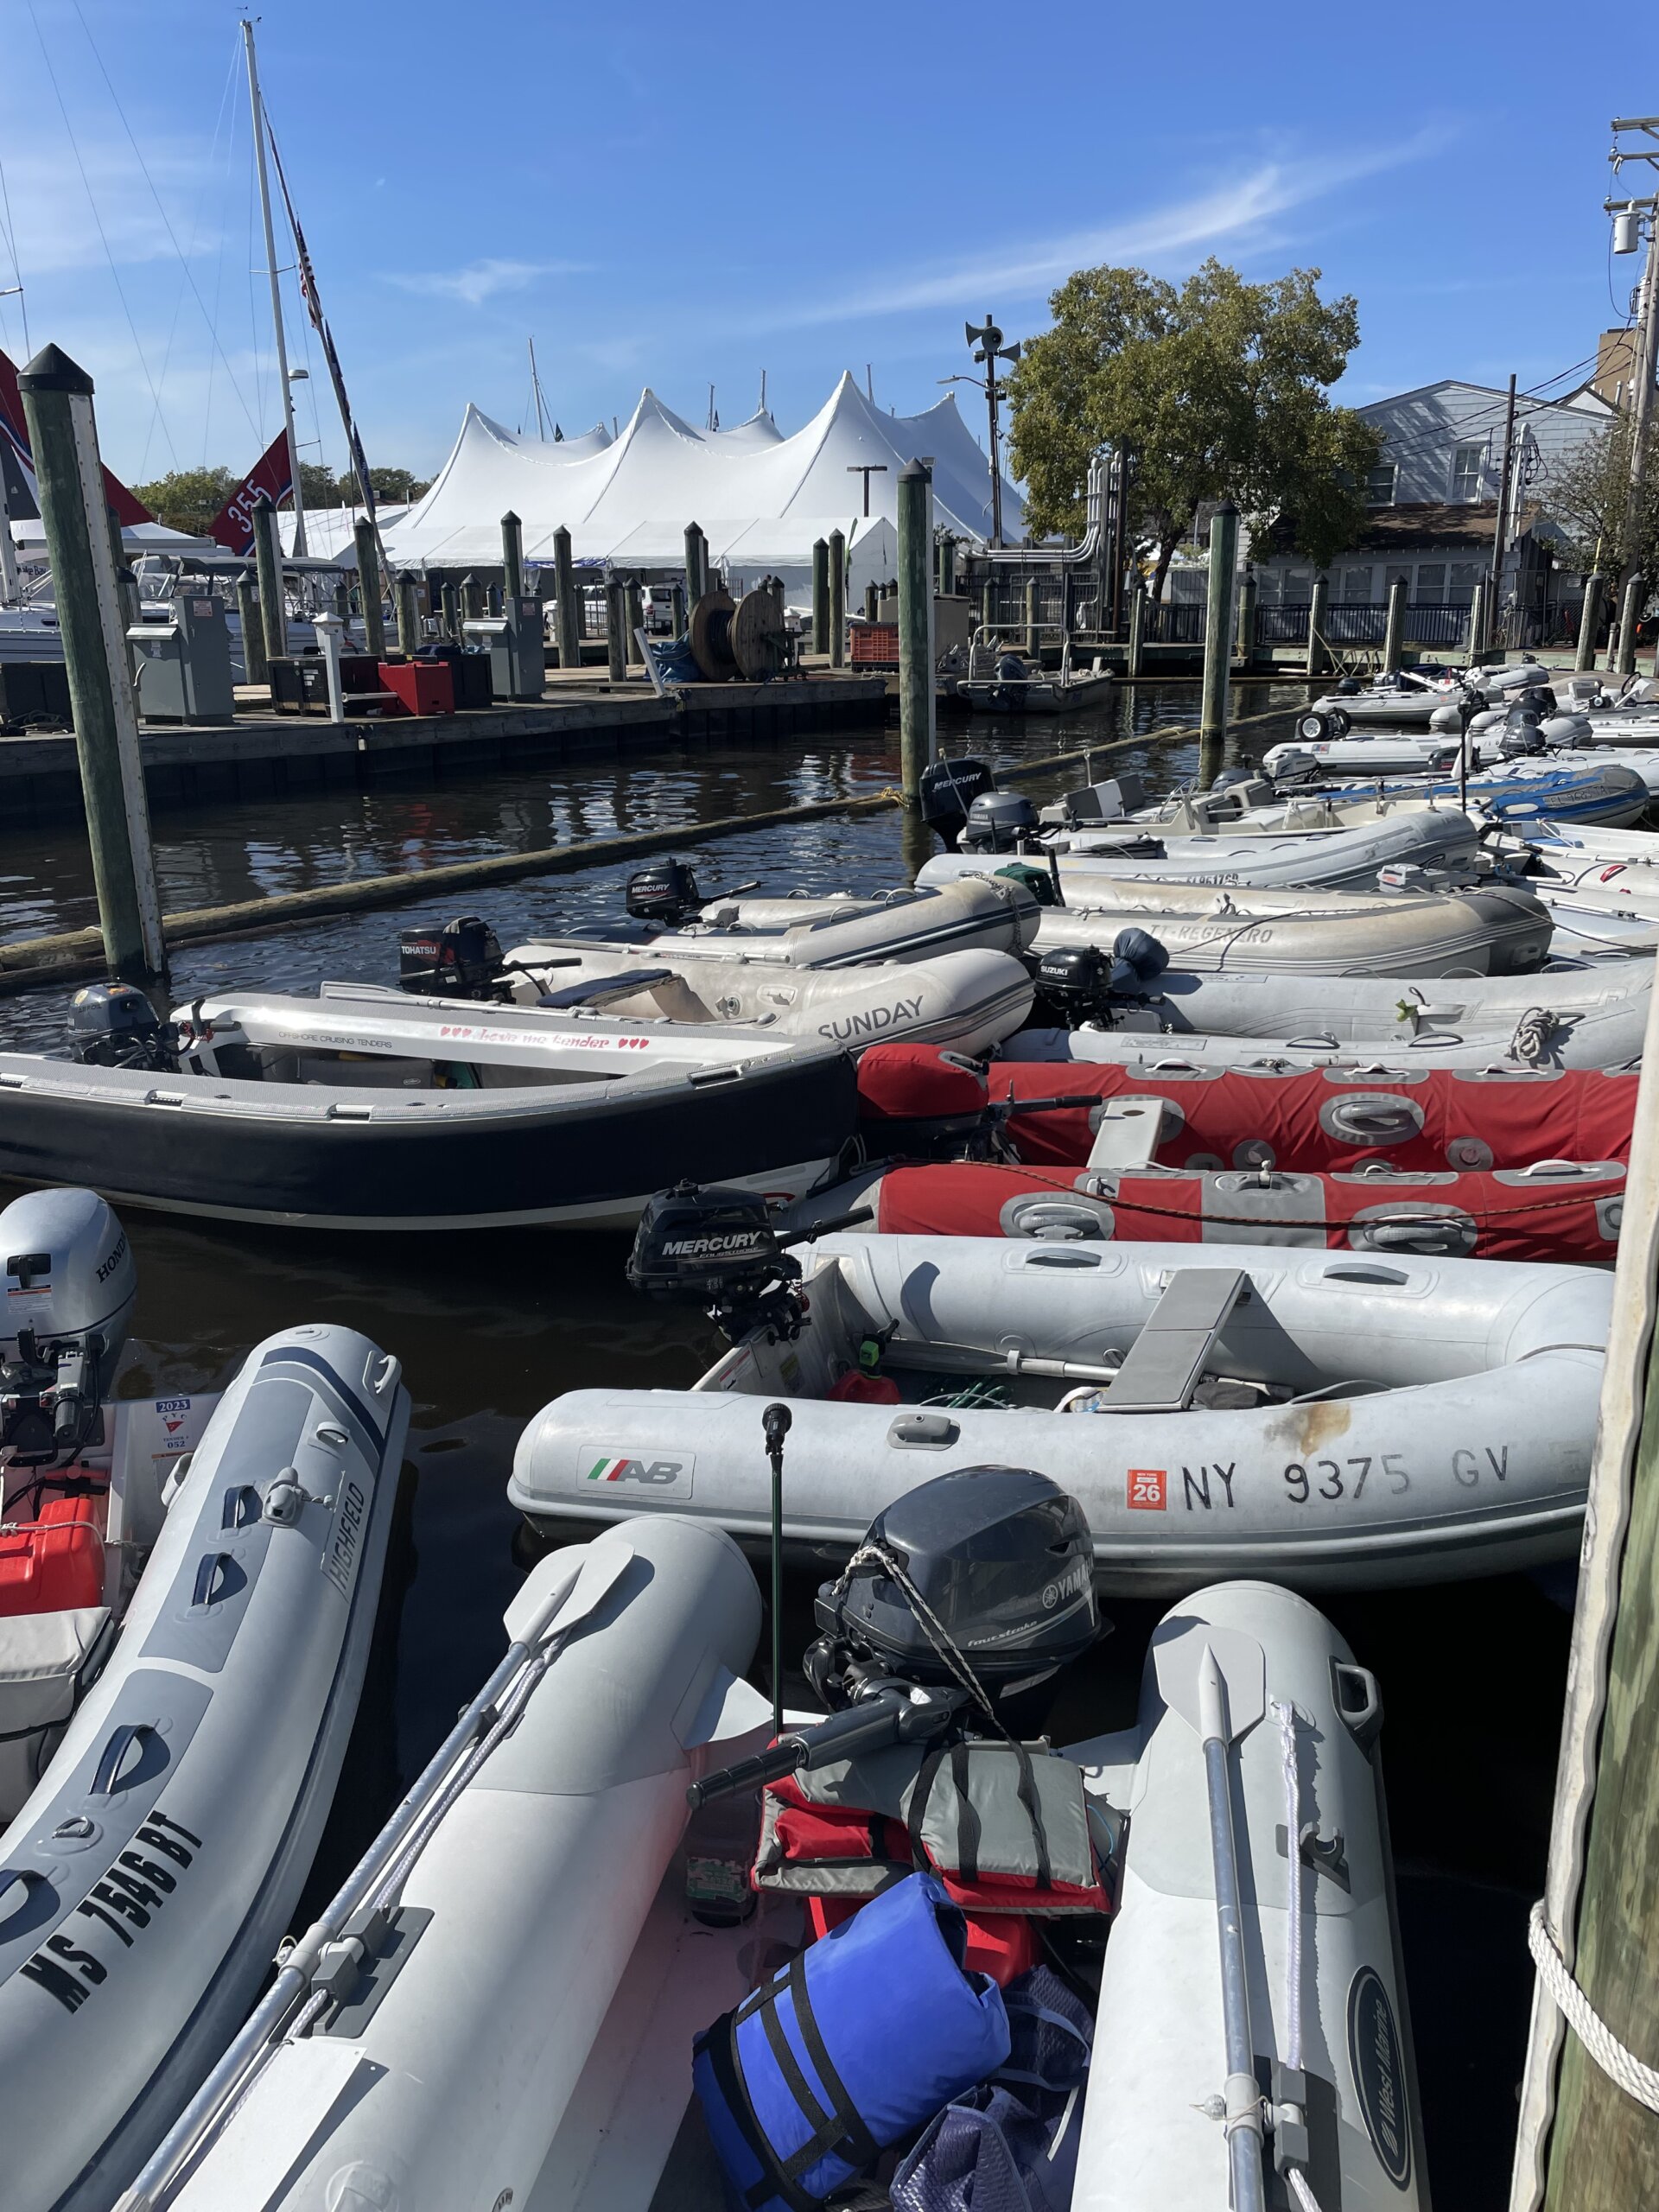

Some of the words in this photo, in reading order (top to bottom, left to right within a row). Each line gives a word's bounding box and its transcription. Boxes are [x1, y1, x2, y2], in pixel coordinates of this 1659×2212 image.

[228, 479, 272, 532] 355
[933, 772, 982, 791] MERCURY
[632, 883, 671, 893] MERCURY
[401, 945, 436, 955] TOHATSU
[1040, 965, 1068, 976] SUZUKI
[817, 995, 924, 1040] SUNDAY
[278, 1031, 318, 1042] OFFSHORE
[320, 1035, 355, 1045] CRUISING
[357, 1039, 392, 1048] TENDERS
[662, 1230, 761, 1255] MERCURY
[159, 1401, 188, 1412] 2023
[617, 1459, 683, 1484] AB
[1182, 1462, 1236, 1510] NY
[1284, 1453, 1410, 1504] 9375
[1452, 1446, 1509, 1488] GV
[1133, 1484, 1160, 1502] 26
[329, 1482, 365, 1591] HIGHFIELD
[968, 1621, 1038, 1647] fourstroke
[19, 1935, 108, 2014] MS
[76, 1851, 177, 1948] 7546
[135, 1810, 203, 1870] BT
[1373, 1999, 1392, 2072] Marine
[1378, 2063, 1395, 2126] West
